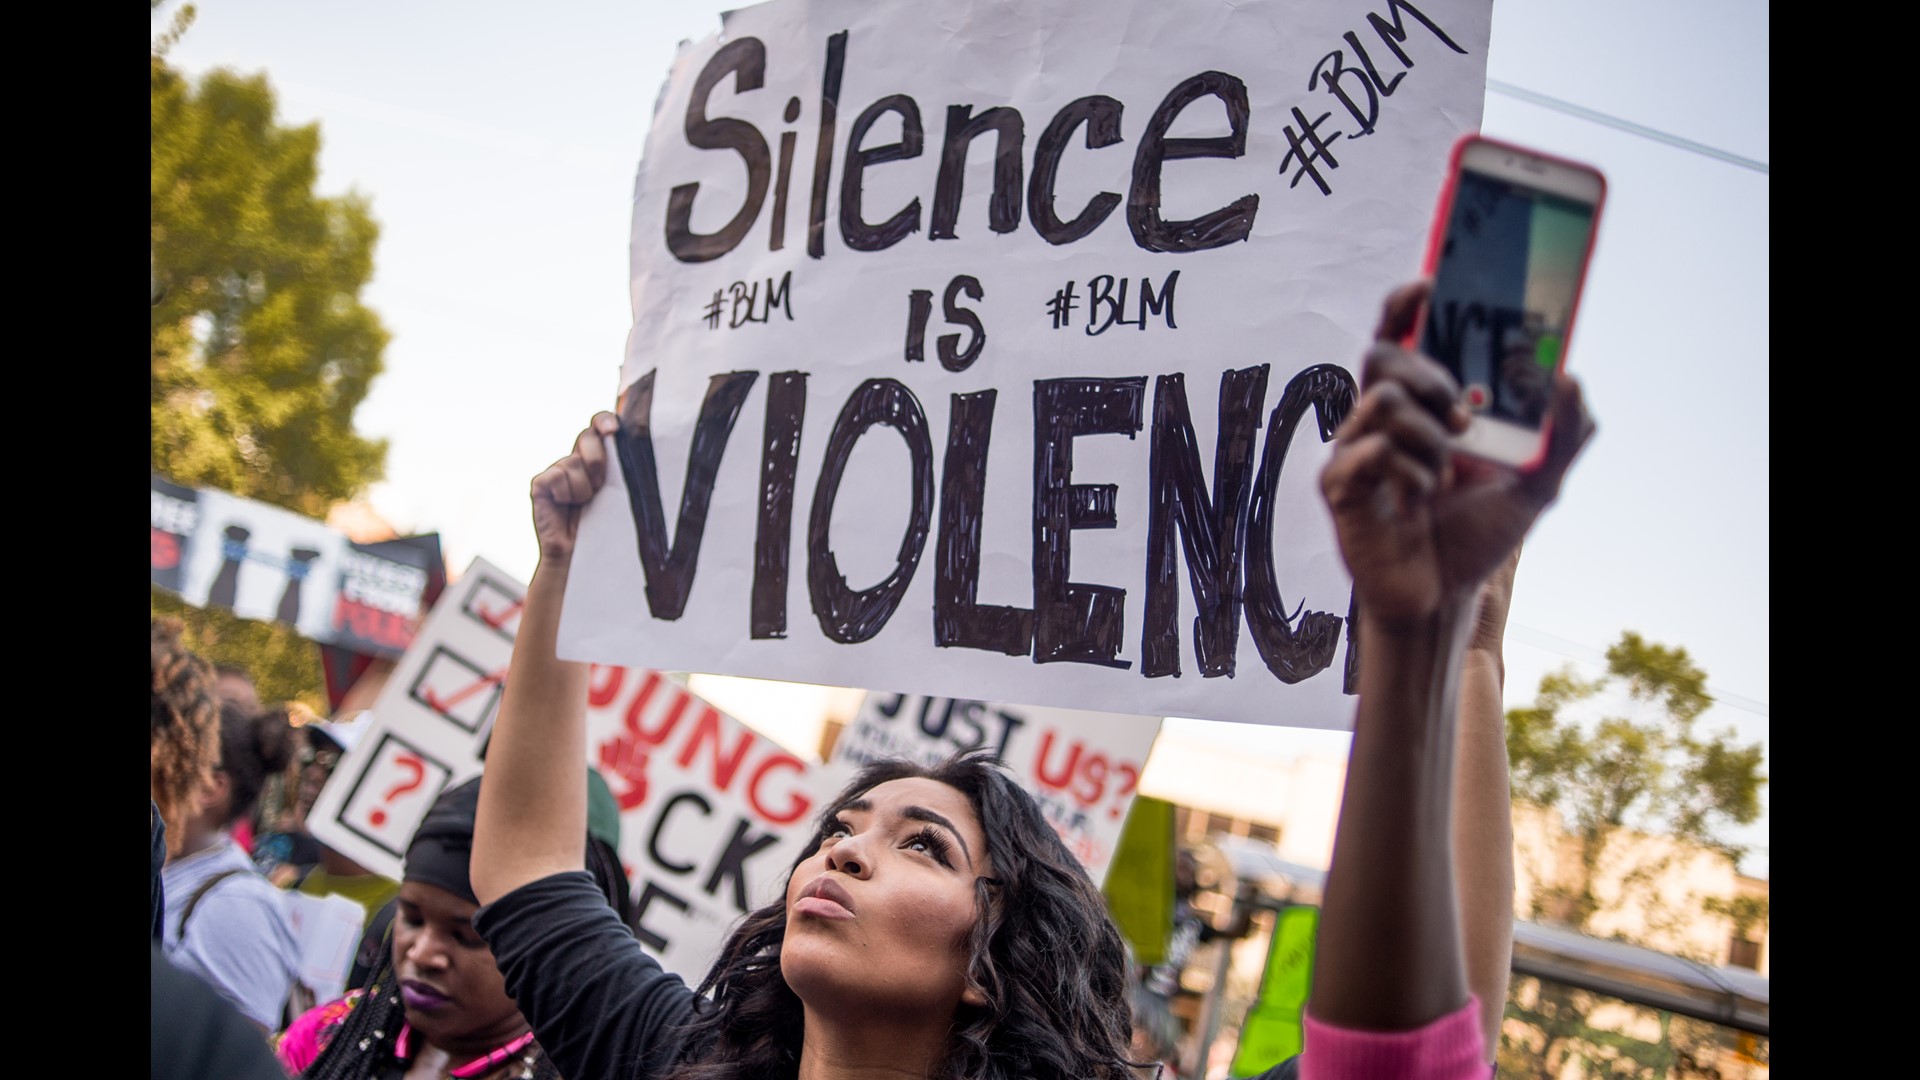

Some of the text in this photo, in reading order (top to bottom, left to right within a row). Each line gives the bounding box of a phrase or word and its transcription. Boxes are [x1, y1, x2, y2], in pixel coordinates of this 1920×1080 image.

[664, 30, 1260, 264] Silence
[1278, 0, 1469, 196] #BLM
[702, 269, 795, 330] #BLM
[1045, 269, 1181, 336] #BLM
[616, 363, 1361, 696] VIOLENC
[1034, 728, 1140, 820] US?
